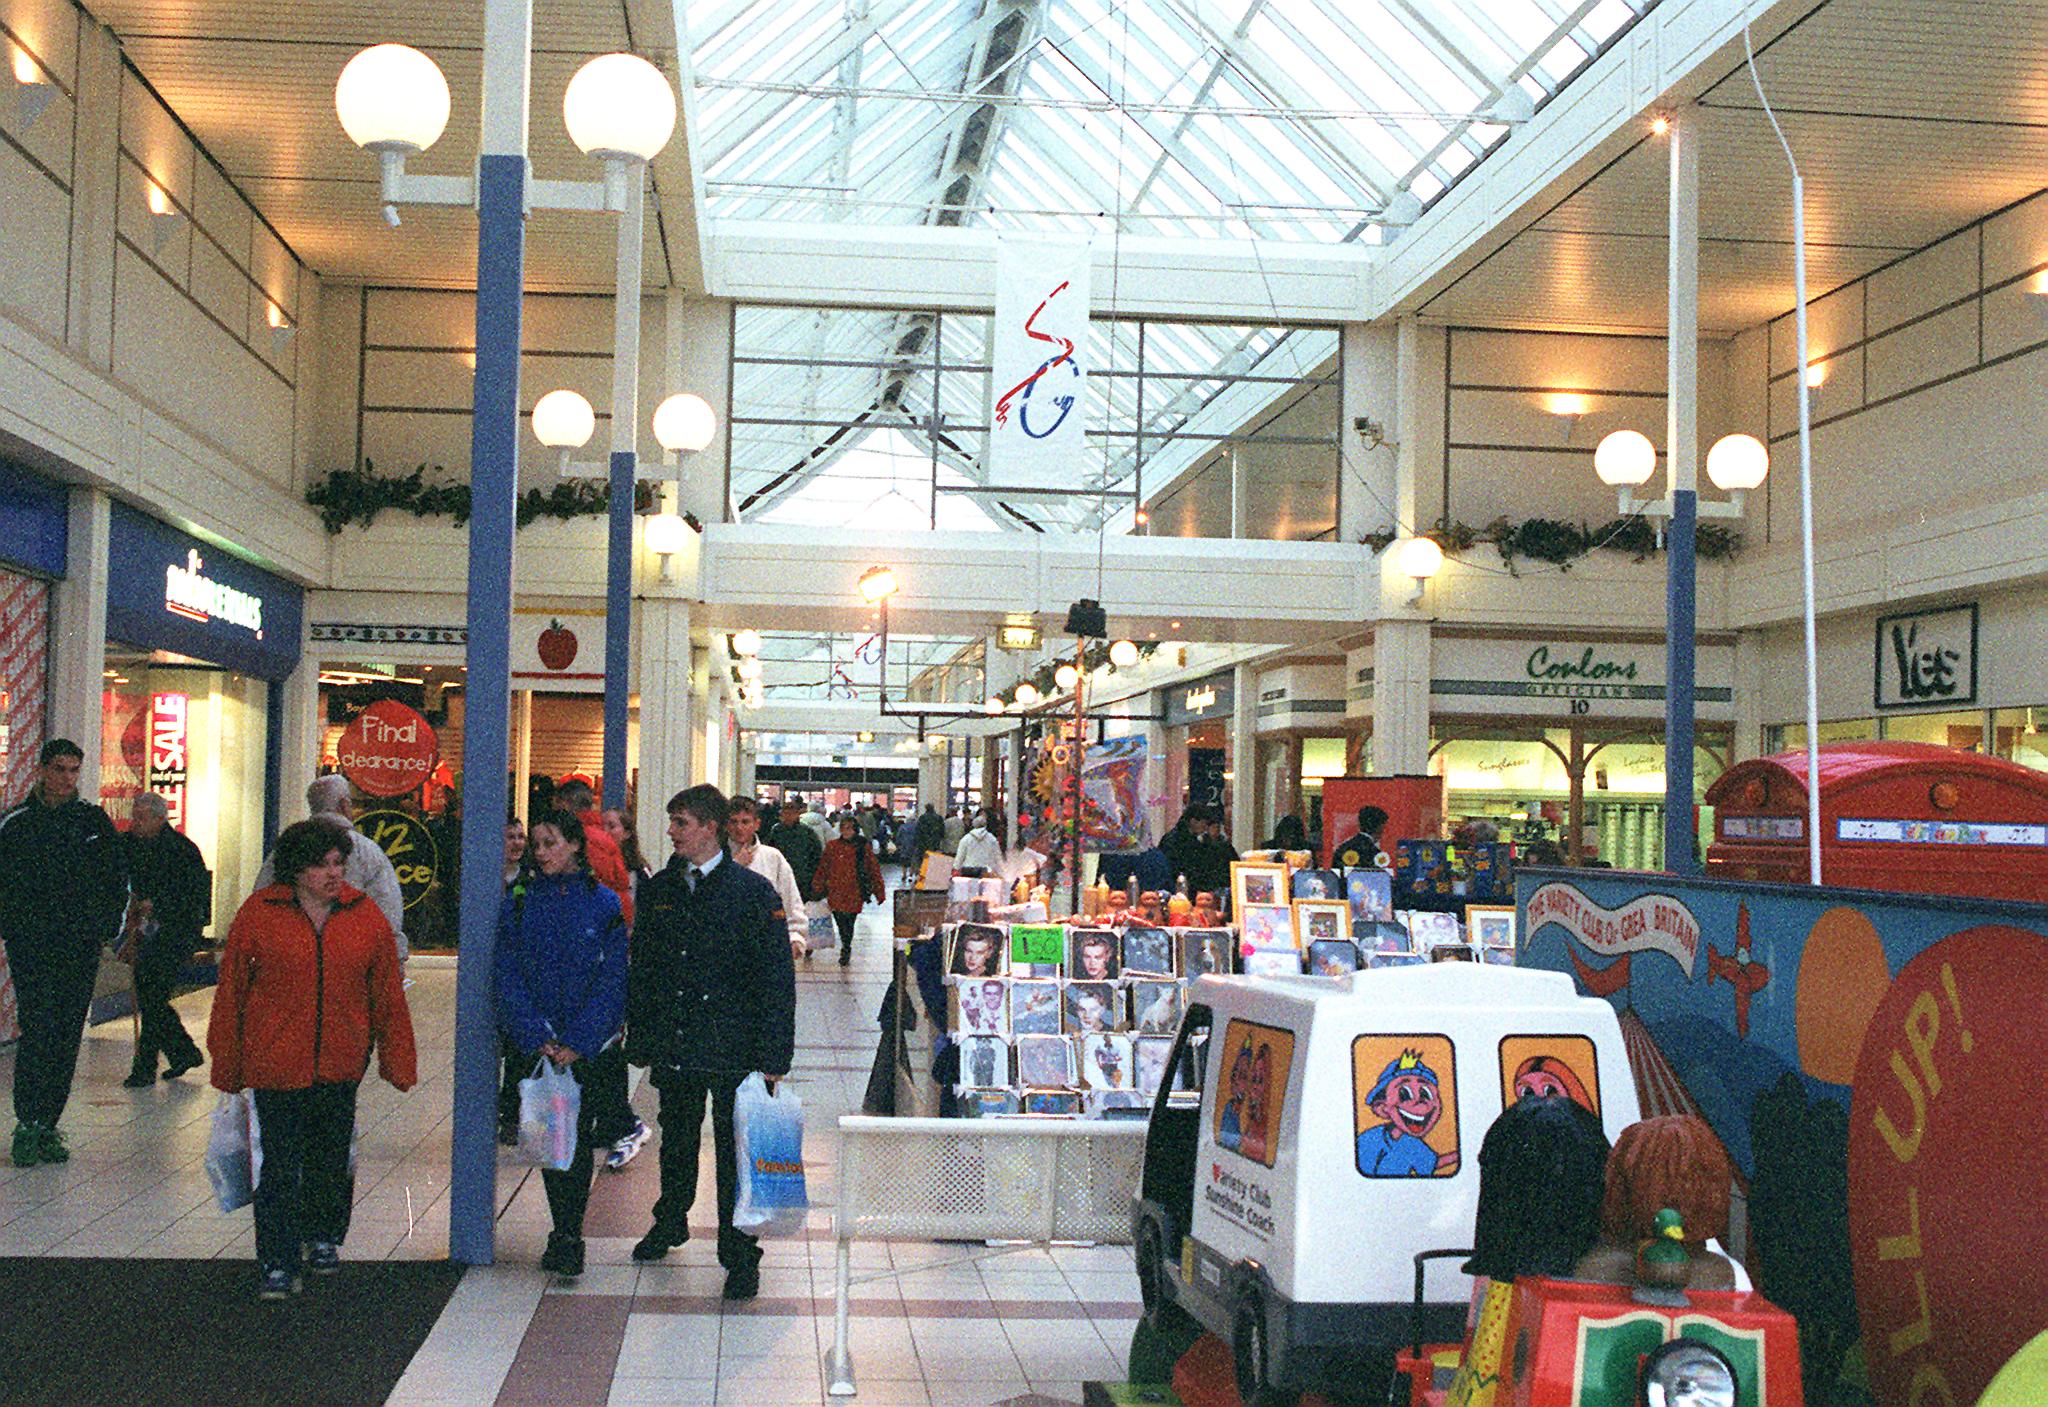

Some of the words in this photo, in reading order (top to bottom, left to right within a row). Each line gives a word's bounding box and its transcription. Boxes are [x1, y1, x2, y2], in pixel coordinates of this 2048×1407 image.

[1526, 645, 1638, 679] Conlons
[1891, 620, 1961, 699] Yes
[1570, 700, 1590, 714] 10
[153, 695, 186, 771] SALE
[361, 714, 418, 744] Final
[341, 750, 434, 773] clearance!
[1581, 909, 1603, 945] CLUB
[1654, 904, 1697, 957] BRITAIN
[1249, 1182, 1273, 1209] Club
[1246, 1207, 1276, 1236] Coach
